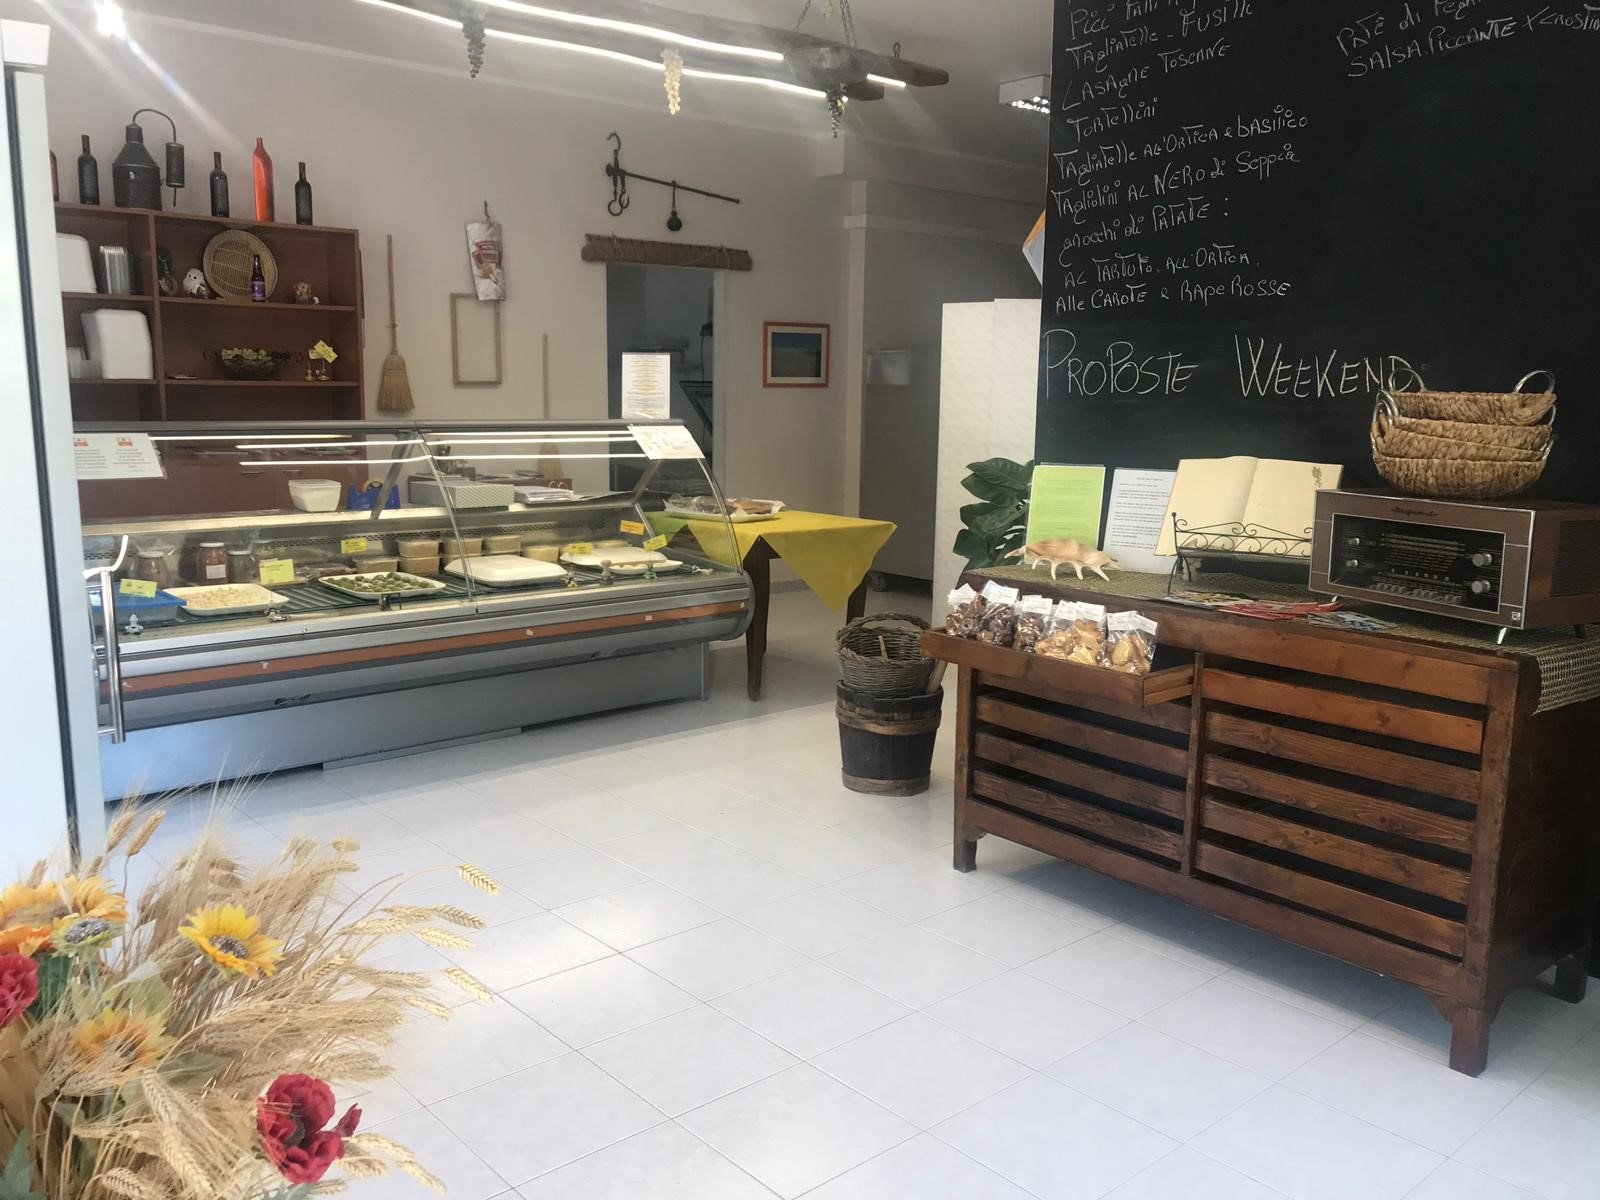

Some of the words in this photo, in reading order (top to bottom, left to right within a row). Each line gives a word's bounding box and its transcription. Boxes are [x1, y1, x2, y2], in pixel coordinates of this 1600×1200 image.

[1157, 37, 1231, 73] TOSCANE
[1223, 126, 1233, 138] e
[1153, 162, 1206, 196] NERO
[1210, 157, 1227, 177] di
[1124, 213, 1145, 238] di
[1152, 195, 1211, 232] PATATE
[1055, 295, 1086, 315] Alle
[1090, 283, 1148, 309] CAROTE
[1160, 286, 1170, 300] e
[1230, 273, 1292, 299] ROSSE
[1043, 328, 1200, 402] PROPOSTE
